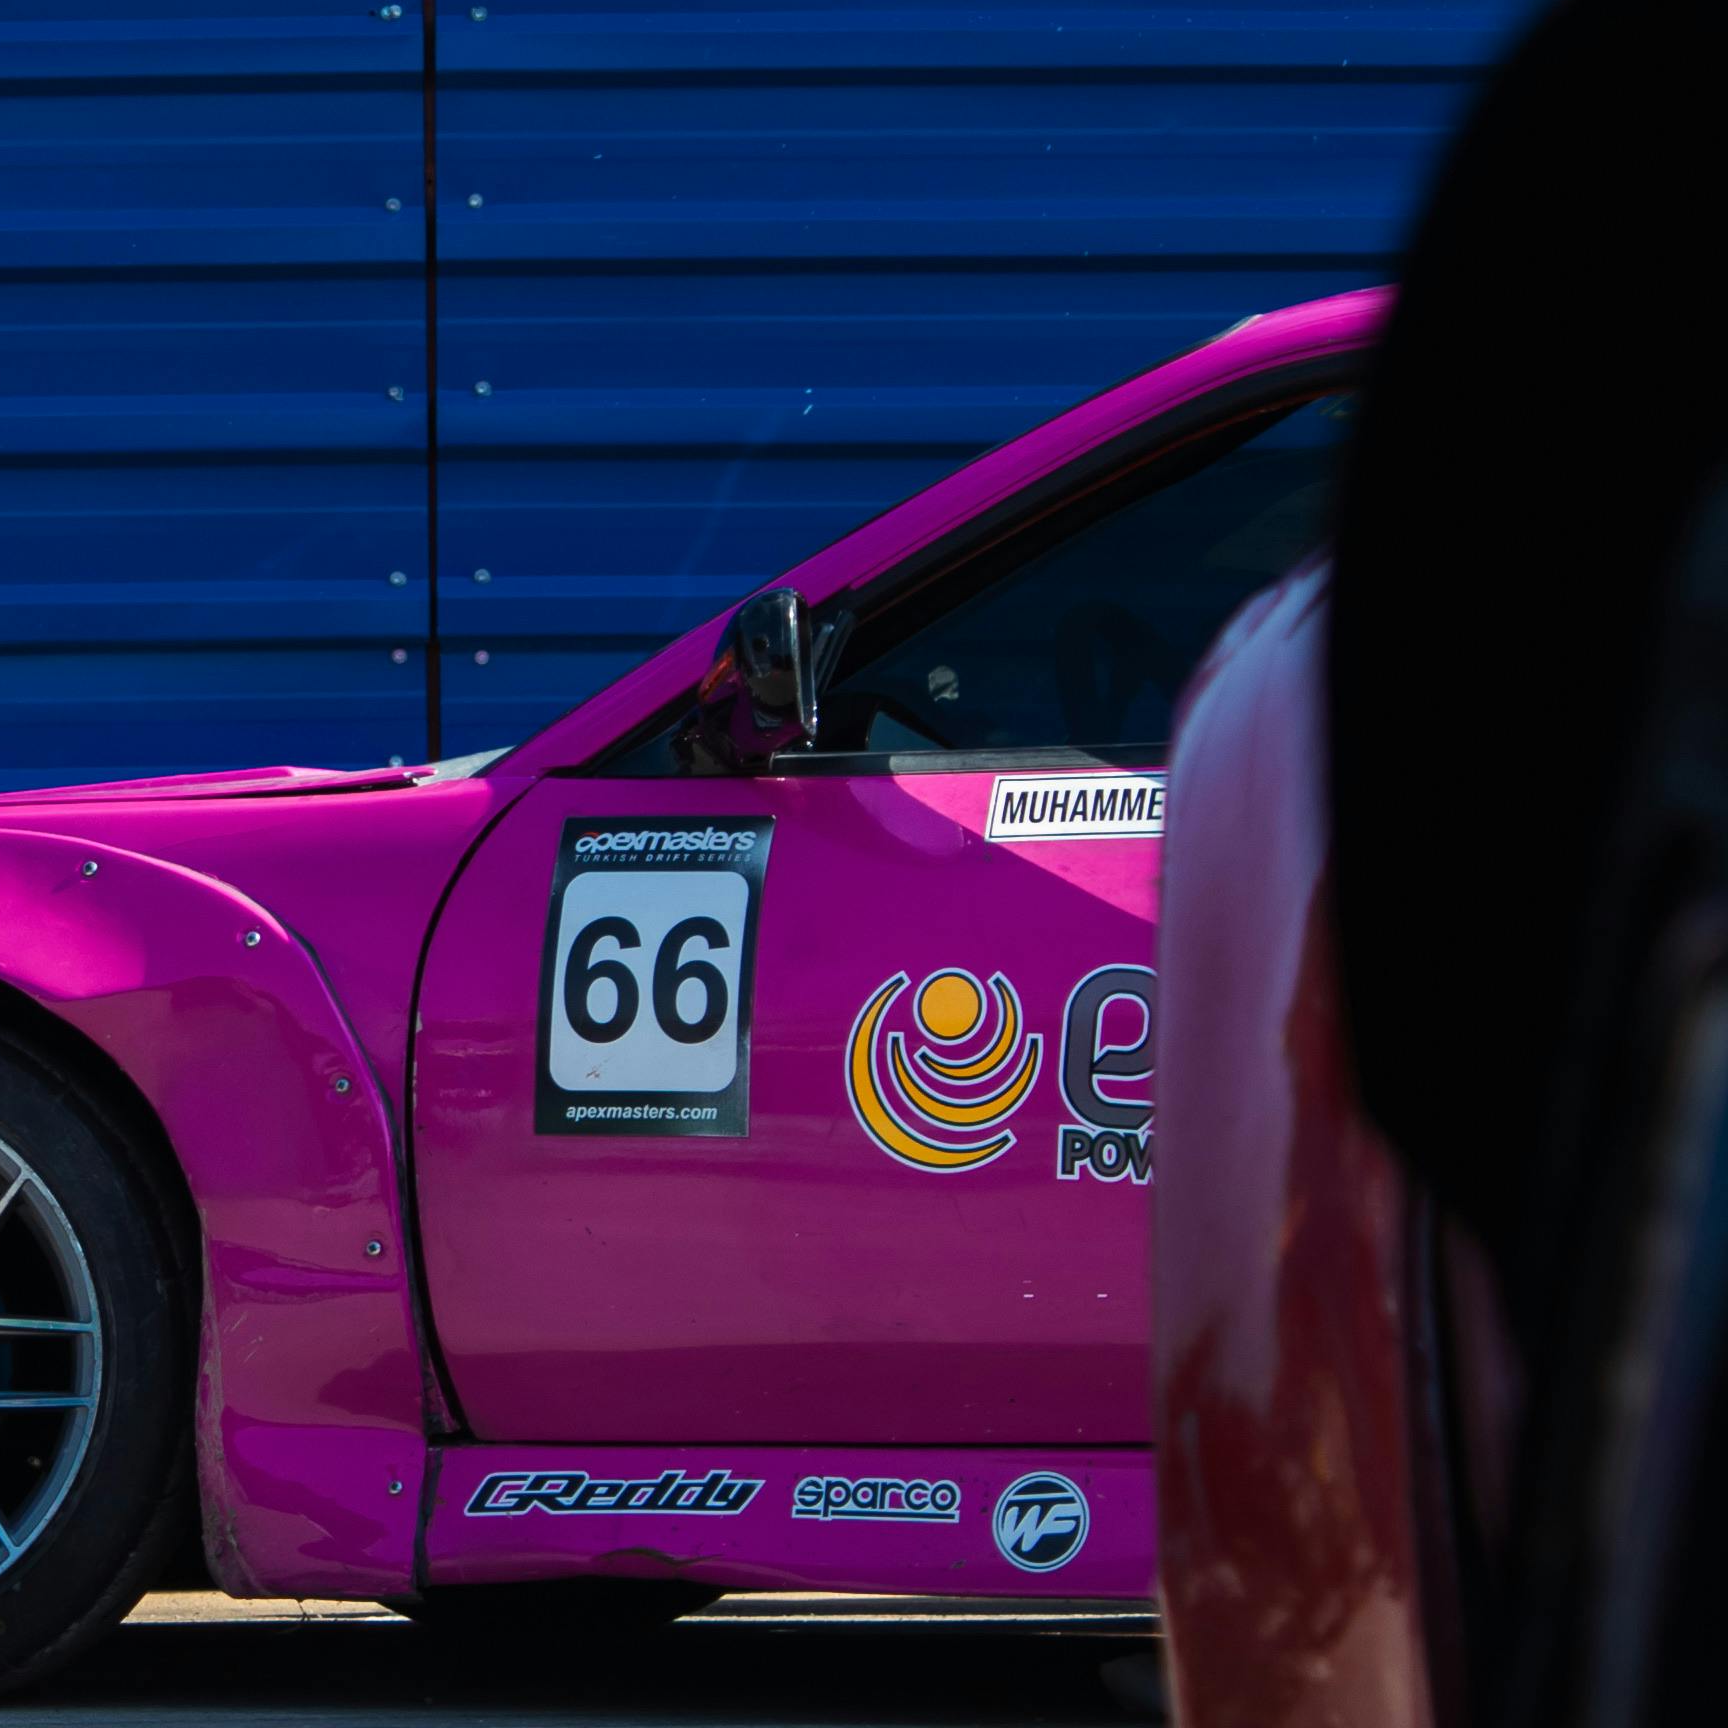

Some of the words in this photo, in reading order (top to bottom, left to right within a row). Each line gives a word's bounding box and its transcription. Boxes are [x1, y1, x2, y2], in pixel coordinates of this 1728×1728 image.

[575, 827, 757, 853] apexmasters
[574, 854, 639, 863] TURKISH
[645, 853, 691, 862] DRIFT
[697, 853, 752, 862] SERIES
[564, 916, 730, 1044] 66
[566, 1104, 718, 1121] apexmasters.com
[464, 1470, 766, 1515] GReddy
[794, 1476, 961, 1519] sparco
